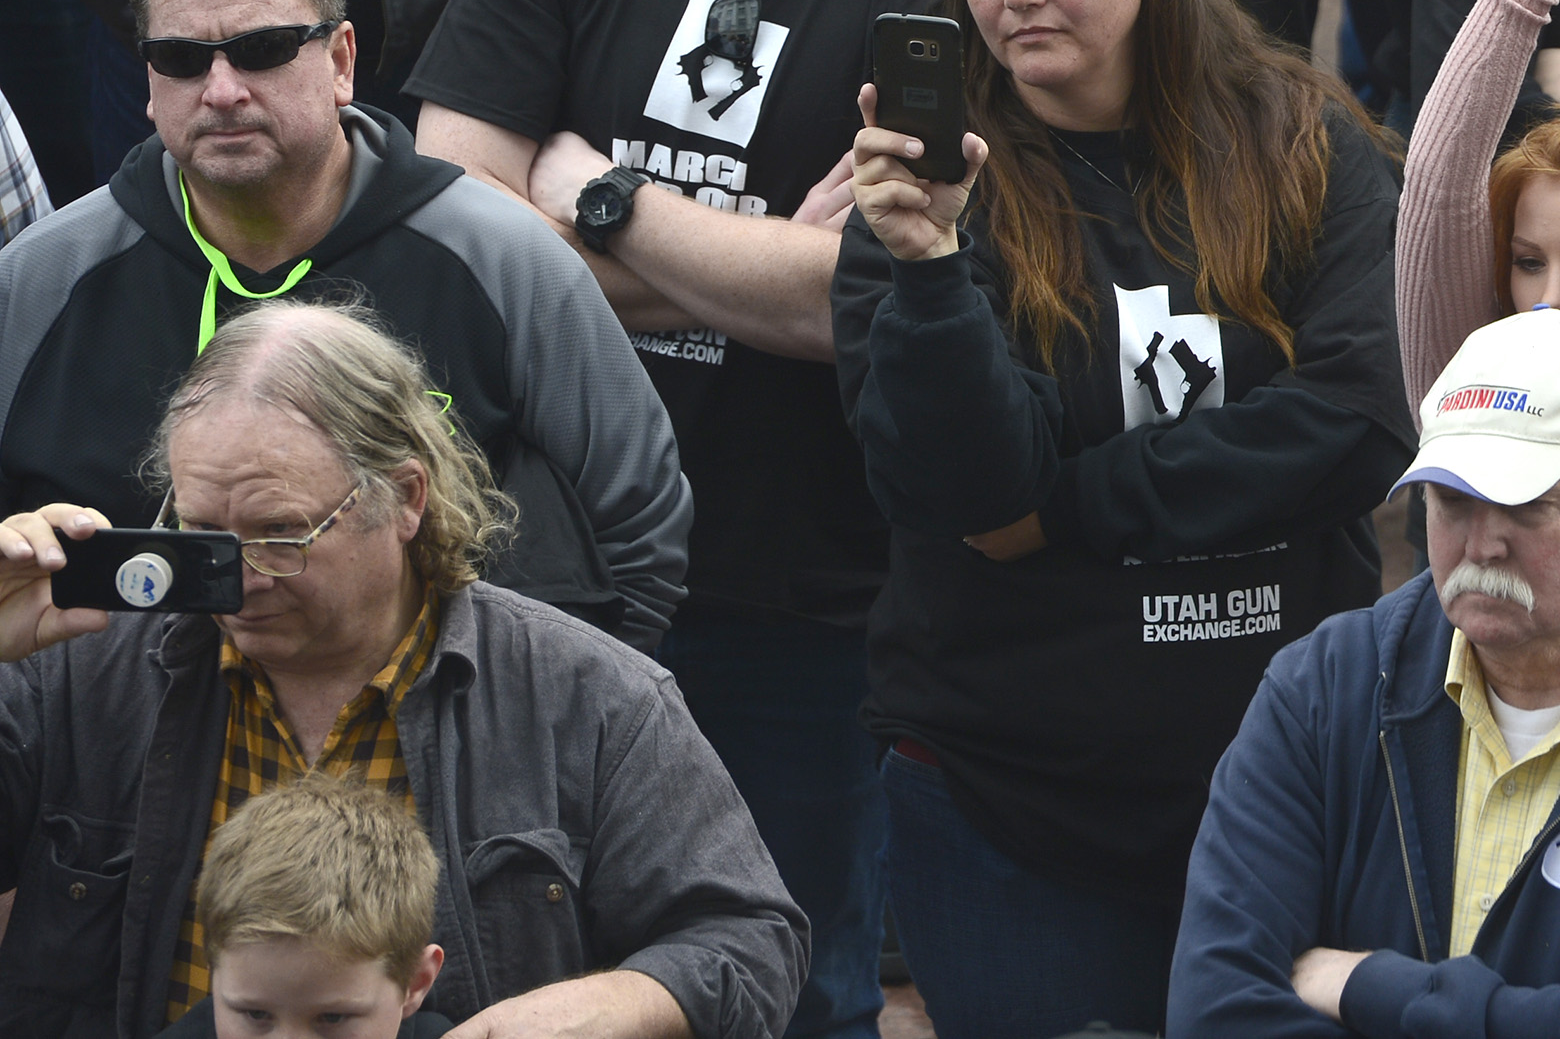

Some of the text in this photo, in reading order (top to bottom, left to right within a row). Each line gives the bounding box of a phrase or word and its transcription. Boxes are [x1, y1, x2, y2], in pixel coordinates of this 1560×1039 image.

[629, 329, 725, 365] HANGE.COM
[1526, 405, 1545, 417] LLC
[1142, 584, 1280, 622] UTAH GUN
[1143, 613, 1281, 642] EXCHANGE.COM
